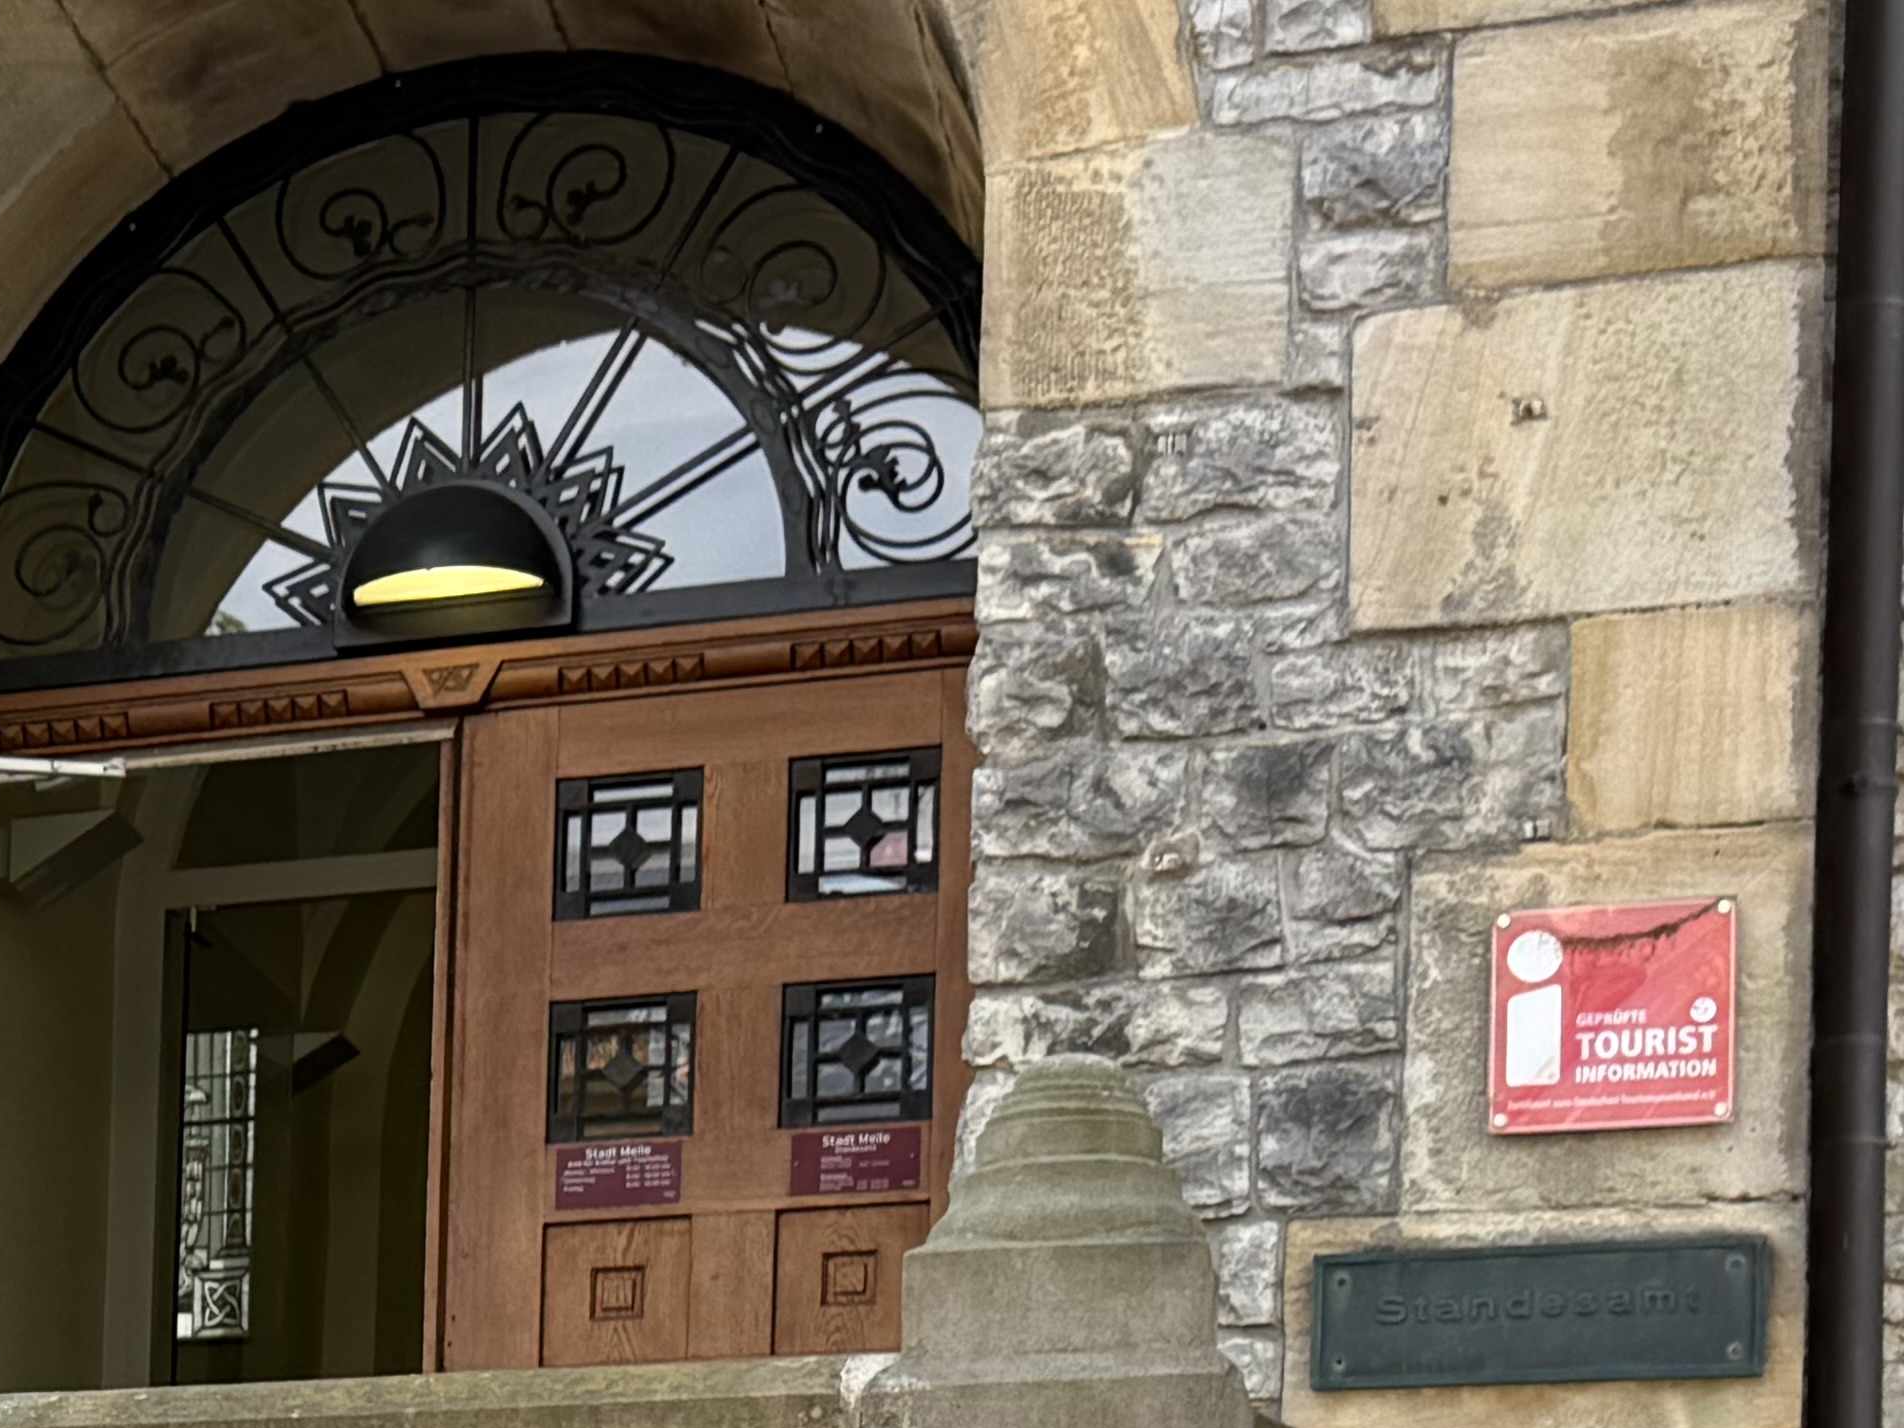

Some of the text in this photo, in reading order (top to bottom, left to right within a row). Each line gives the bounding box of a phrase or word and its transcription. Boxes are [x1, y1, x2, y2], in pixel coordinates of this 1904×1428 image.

[1575, 1024, 1718, 1060] TOURIST
[1575, 1059, 1717, 1083] INFORMATION
[1376, 1287, 1700, 1325] Standesamt
